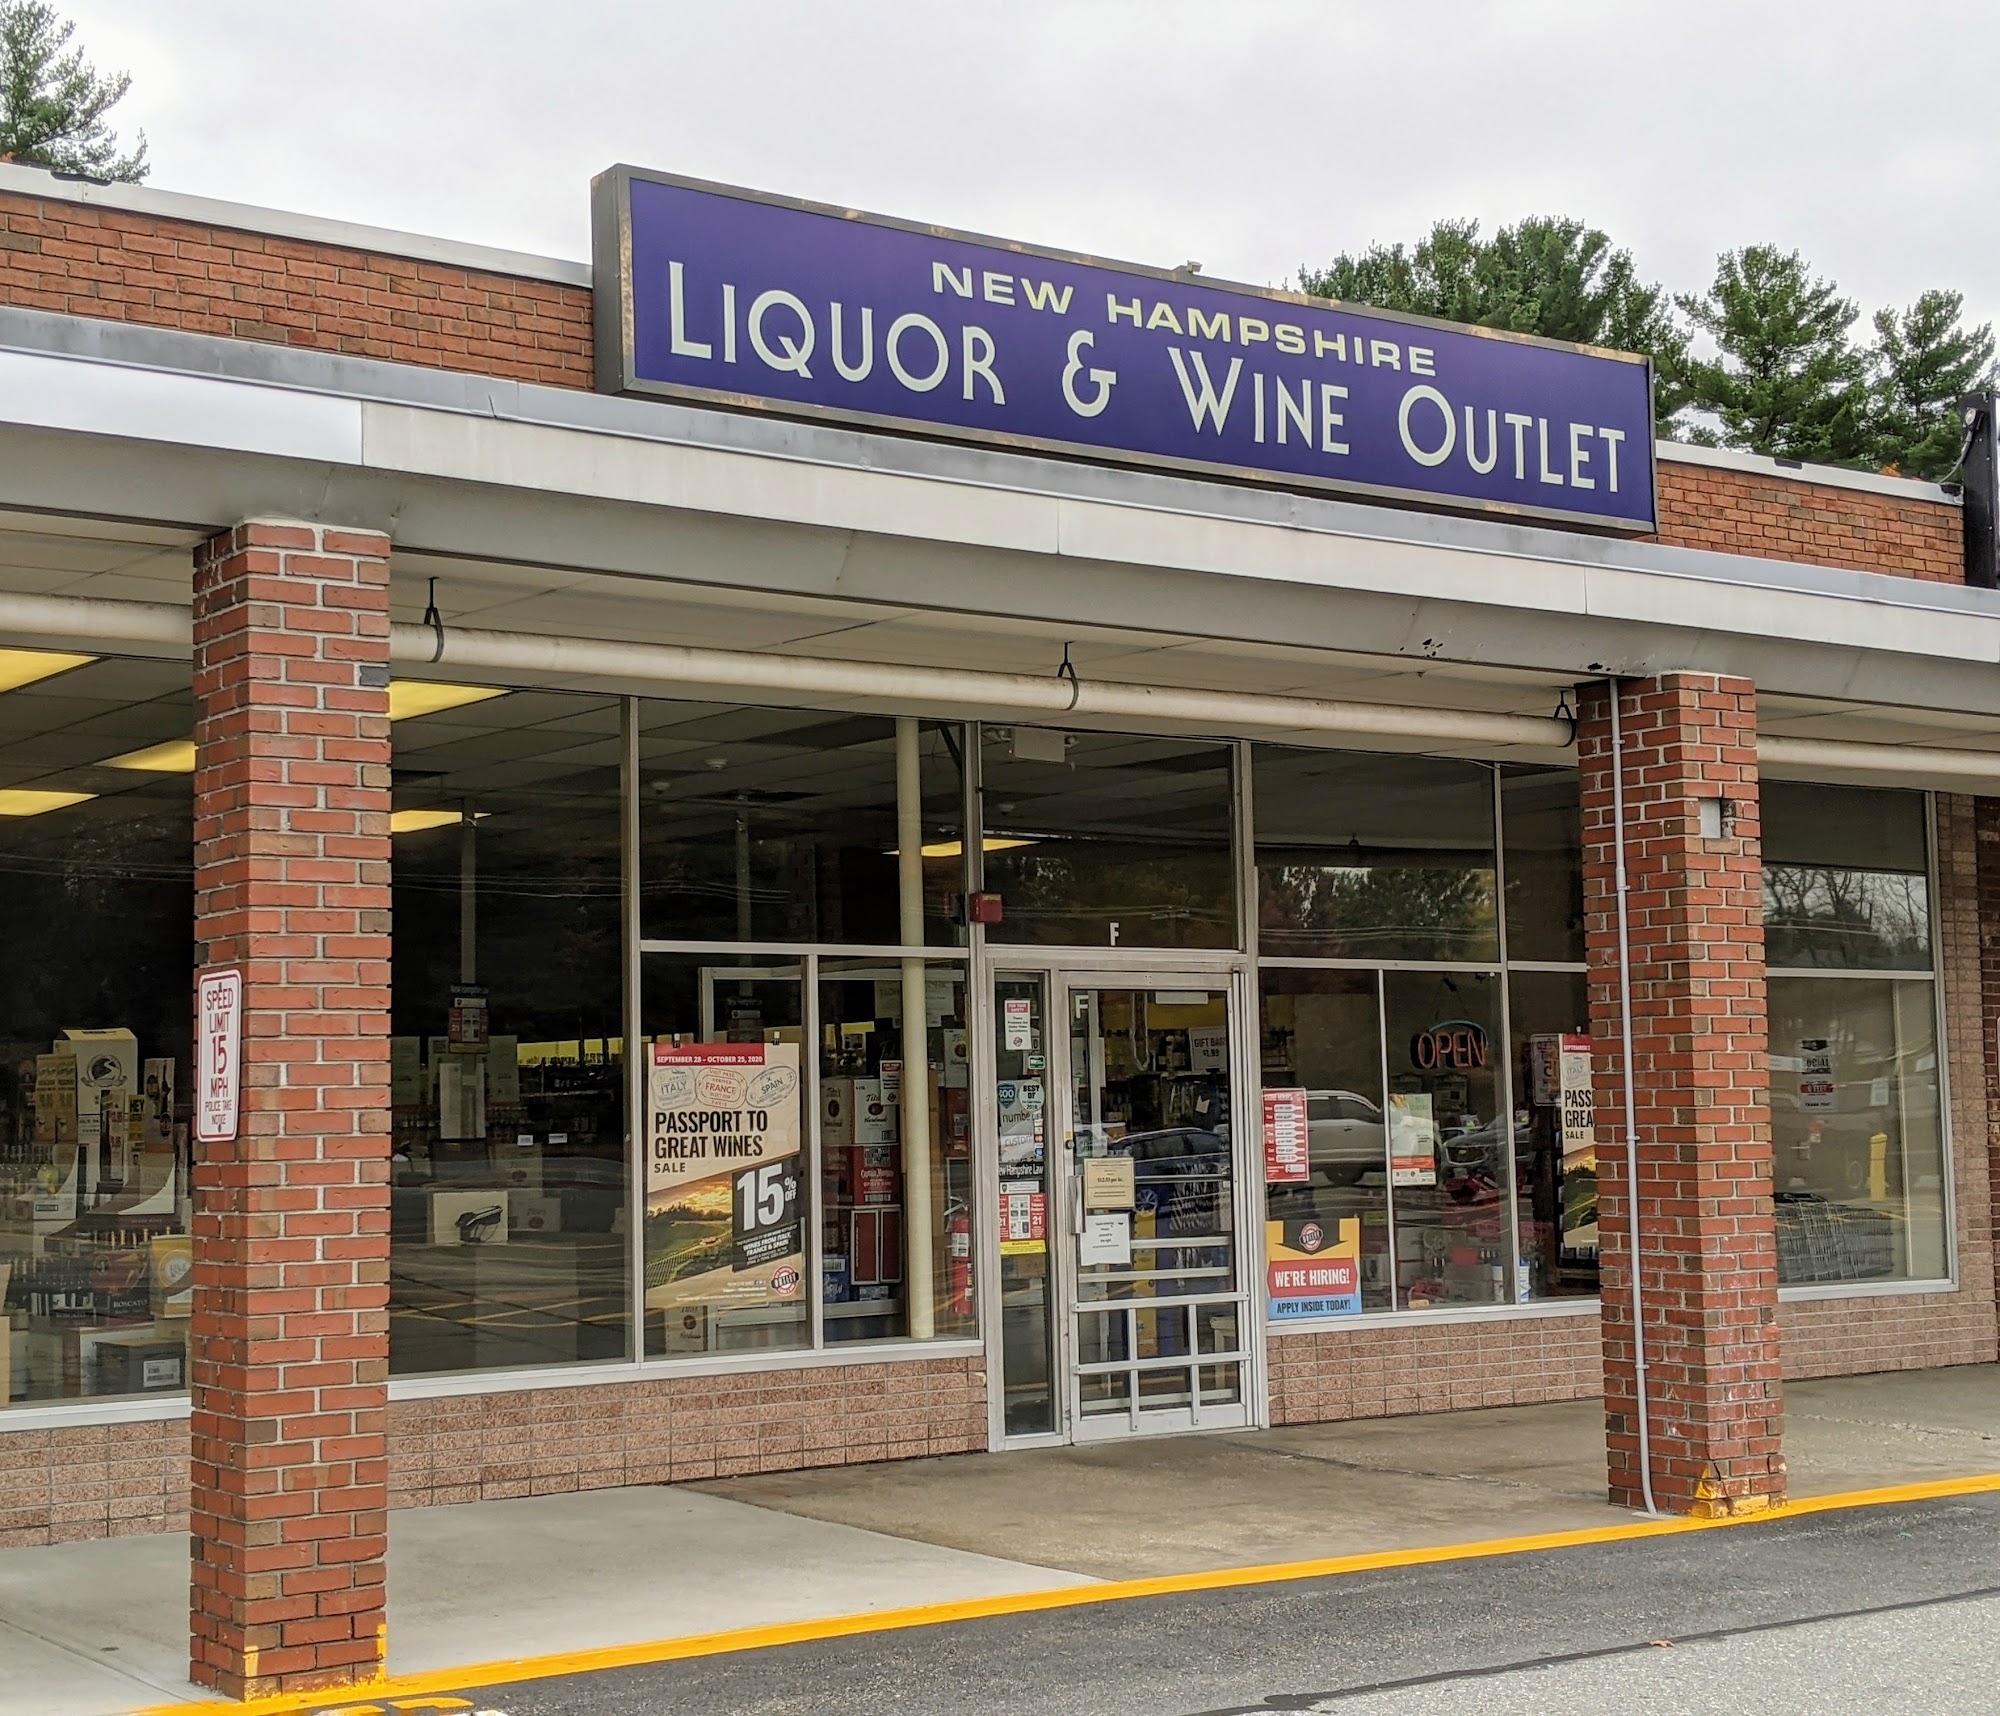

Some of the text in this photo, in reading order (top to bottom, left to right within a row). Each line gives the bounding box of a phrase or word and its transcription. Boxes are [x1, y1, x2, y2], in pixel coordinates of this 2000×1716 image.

[932, 261, 1437, 377] NEW HAMPSHIRE
[668, 260, 1626, 493] LIQUOR & WINE OUTLET
[1110, 922, 1119, 946] F
[206, 987, 234, 1011] SPEED
[1075, 995, 1089, 1019] F
[209, 1011, 230, 1034] LIMIT
[1194, 1037, 1209, 1047] GIFT
[1417, 1030, 1487, 1069] OPEN
[212, 1034, 228, 1075] 15
[1566, 1065, 1584, 1077] ITALY
[210, 1076, 229, 1099] MPH
[661, 1081, 687, 1095] ITALY
[705, 1082, 736, 1095] FRANCE
[761, 1077, 784, 1095] SPAIN
[205, 1101, 221, 1112] POLICE
[1564, 1089, 1592, 1108] PASS
[211, 1113, 226, 1125] NOTICE
[655, 1110, 768, 1133] PASSPORT TO
[1565, 1110, 1593, 1127] GREA
[1565, 1130, 1584, 1140] SALE
[655, 1135, 763, 1159] GREAT WINES
[654, 1163, 686, 1173] SALE
[1033, 1163, 1044, 1175] Law
[784, 1176, 797, 1190] %
[737, 1163, 785, 1232] 15
[785, 1189, 797, 1201] OFF
[1032, 1216, 1042, 1225] 21
[1274, 1267, 1350, 1288] WE'RE HIRING!
[113, 1300, 148, 1308] ROSCATO
[1277, 1299, 1351, 1314] APPLY INSIDE TODAY!
